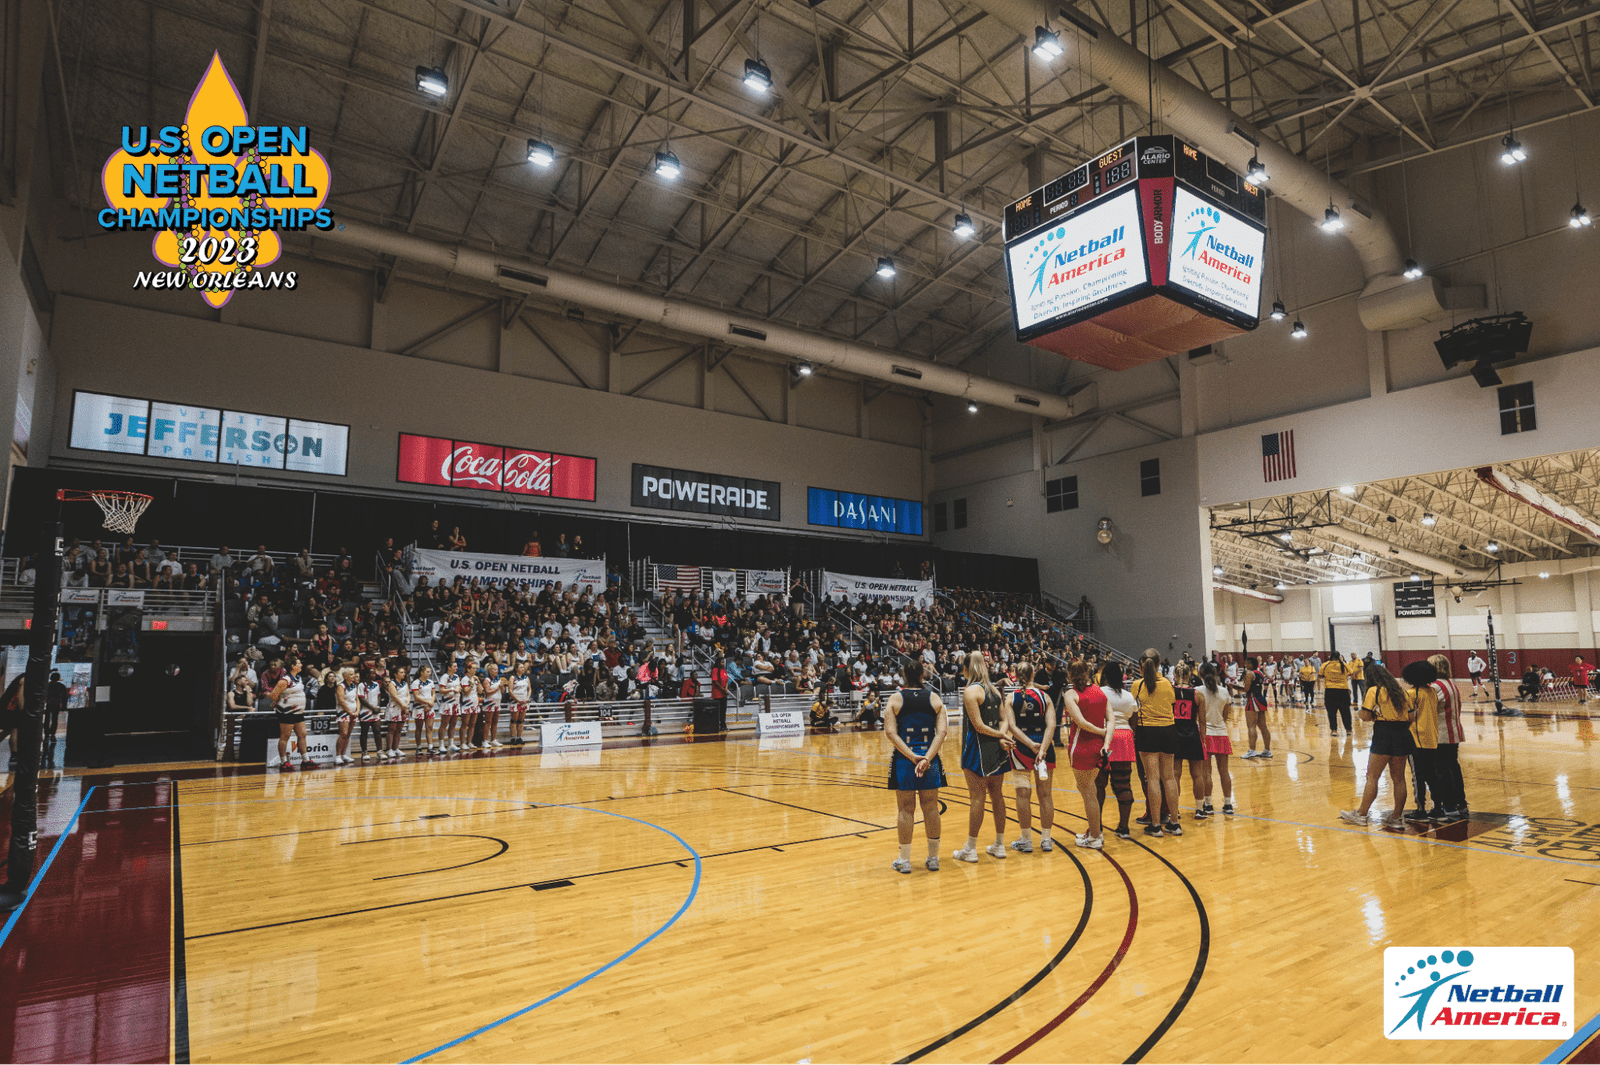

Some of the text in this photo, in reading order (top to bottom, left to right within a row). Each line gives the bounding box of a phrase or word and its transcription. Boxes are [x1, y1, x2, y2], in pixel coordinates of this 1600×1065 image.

[1098, 147, 1124, 169] GUEST
[1140, 152, 1171, 160] ALARIO
[1183, 144, 1198, 161] HOME
[1211, 184, 1226, 197] PERIOD
[1243, 181, 1259, 197] GUEST
[1015, 196, 1033, 212] HOME
[1049, 200, 1069, 214] PERIOD
[1153, 189, 1164, 245] BODYARMOR
[1054, 225, 1125, 269] Netball
[1206, 234, 1254, 268] Netball
[1048, 247, 1126, 288] America
[1198, 250, 1251, 285] America
[104, 412, 323, 458] JEFFERSON
[163, 445, 271, 465] PARISH
[642, 476, 768, 510] POWERADE
[833, 498, 897, 525] DASANI
[450, 559, 561, 575] U.S. OPEN NETBALL
[868, 582, 889, 591] OPEN
[890, 584, 918, 592] NETBALL
[1507, 651, 1517, 664] 3
[600, 709, 612, 717] 104
[1180, 702, 1187, 717] C
[313, 720, 329, 730] 105
